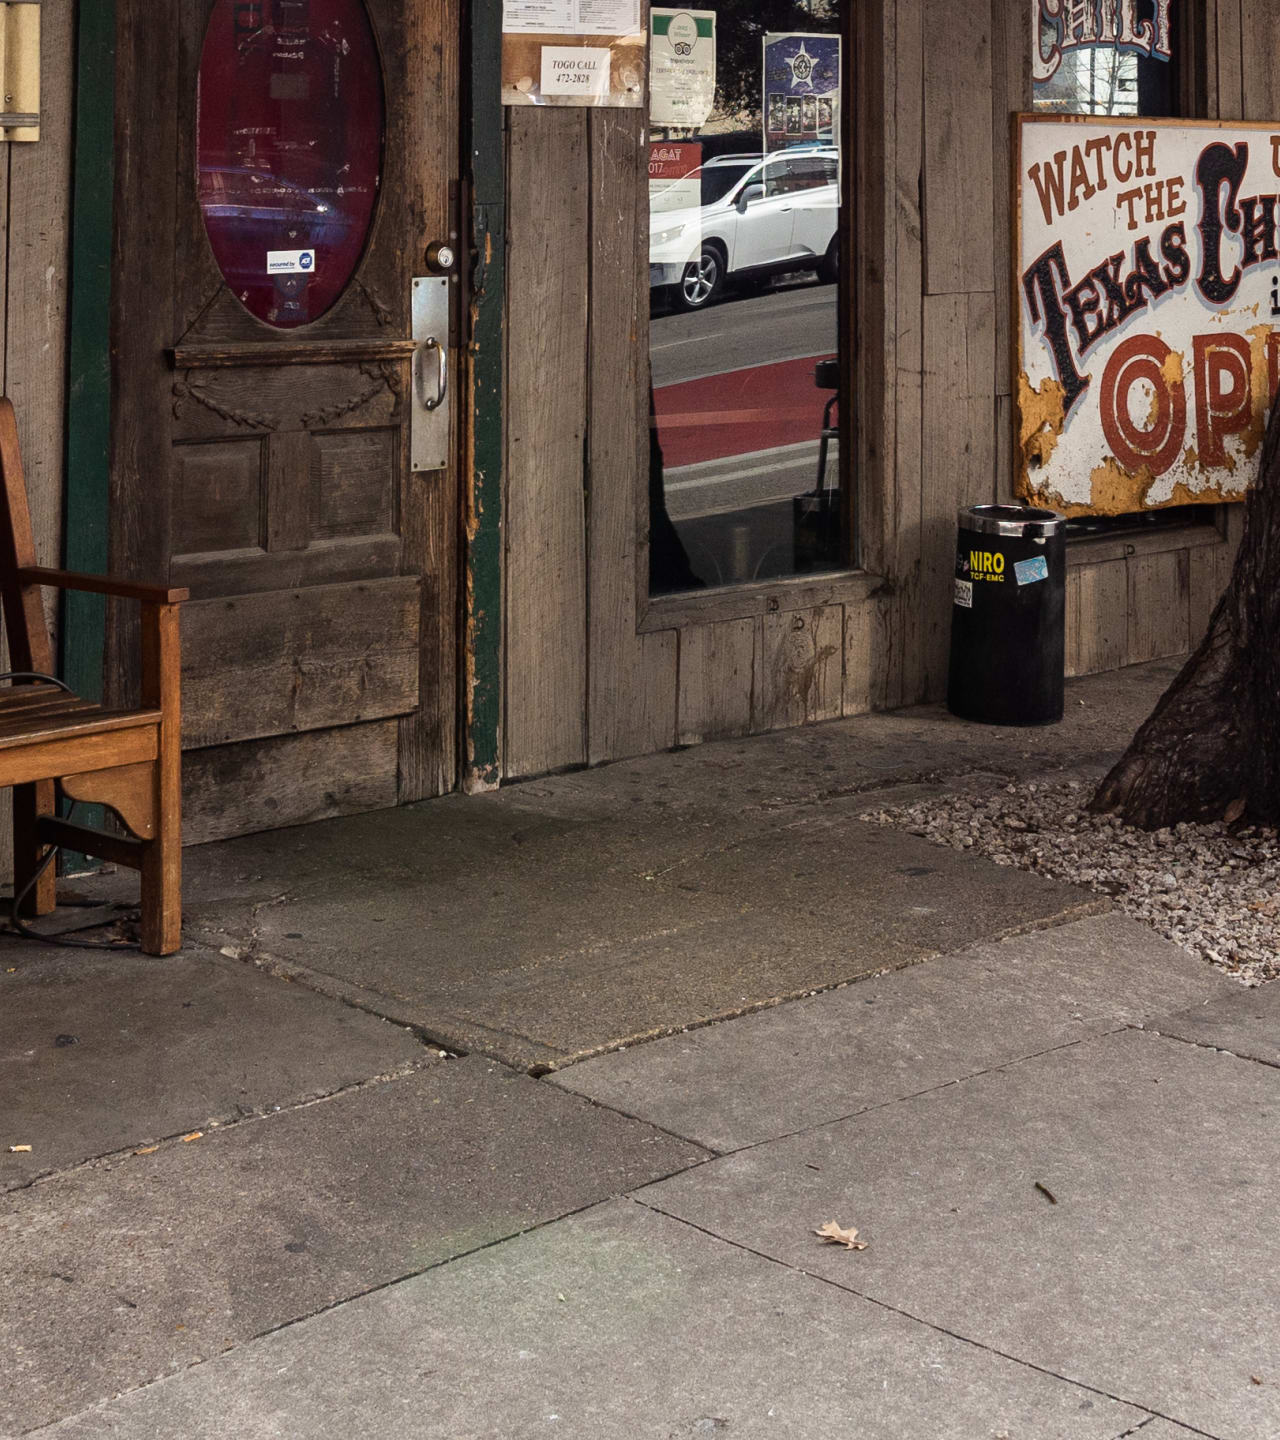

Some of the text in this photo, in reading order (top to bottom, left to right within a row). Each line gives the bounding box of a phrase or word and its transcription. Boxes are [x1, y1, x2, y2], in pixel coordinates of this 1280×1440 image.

[552, 60, 598, 70] TOGO CALL
[1027, 130, 1157, 226] WATCH
[1116, 175, 1188, 231] THE
[1021, 220, 1192, 418] TEXAS
[970, 550, 1006, 574] NIRO
